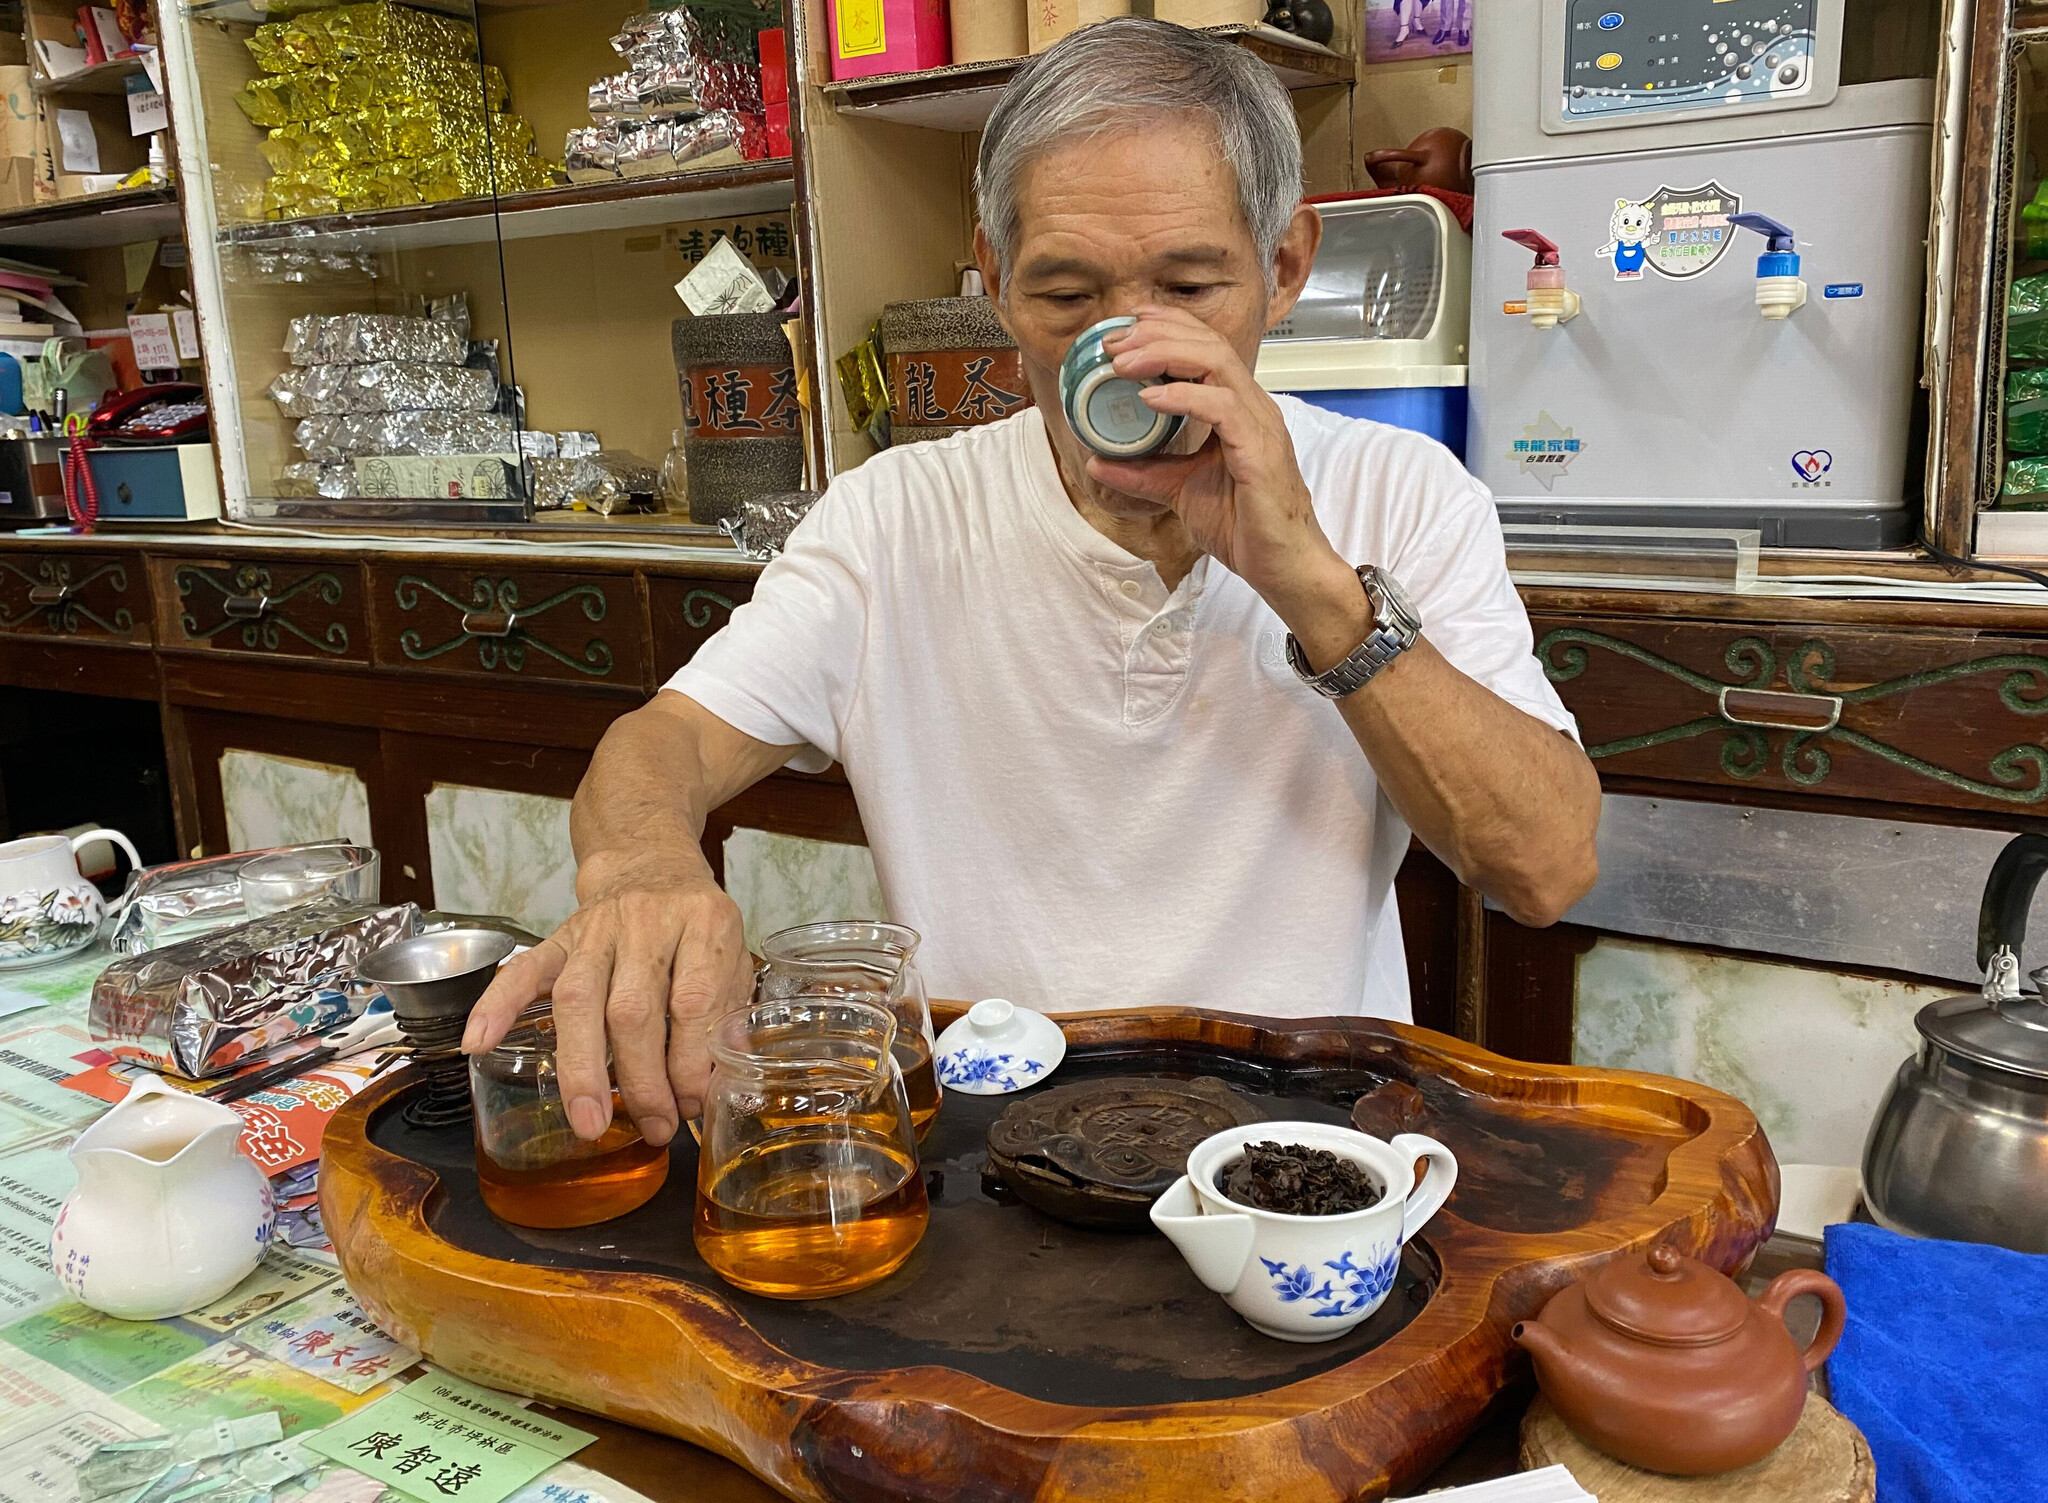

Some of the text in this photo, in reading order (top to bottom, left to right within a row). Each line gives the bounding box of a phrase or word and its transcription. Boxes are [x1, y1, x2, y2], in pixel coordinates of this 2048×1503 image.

[888, 356, 1027, 421] 龍茶
[1513, 439, 1581, 452] 東龍家電
[288, 1329, 390, 1376] 陳天佑
[412, 1410, 518, 1456] 新北市坪林區
[347, 1430, 482, 1496] 陳智遠
